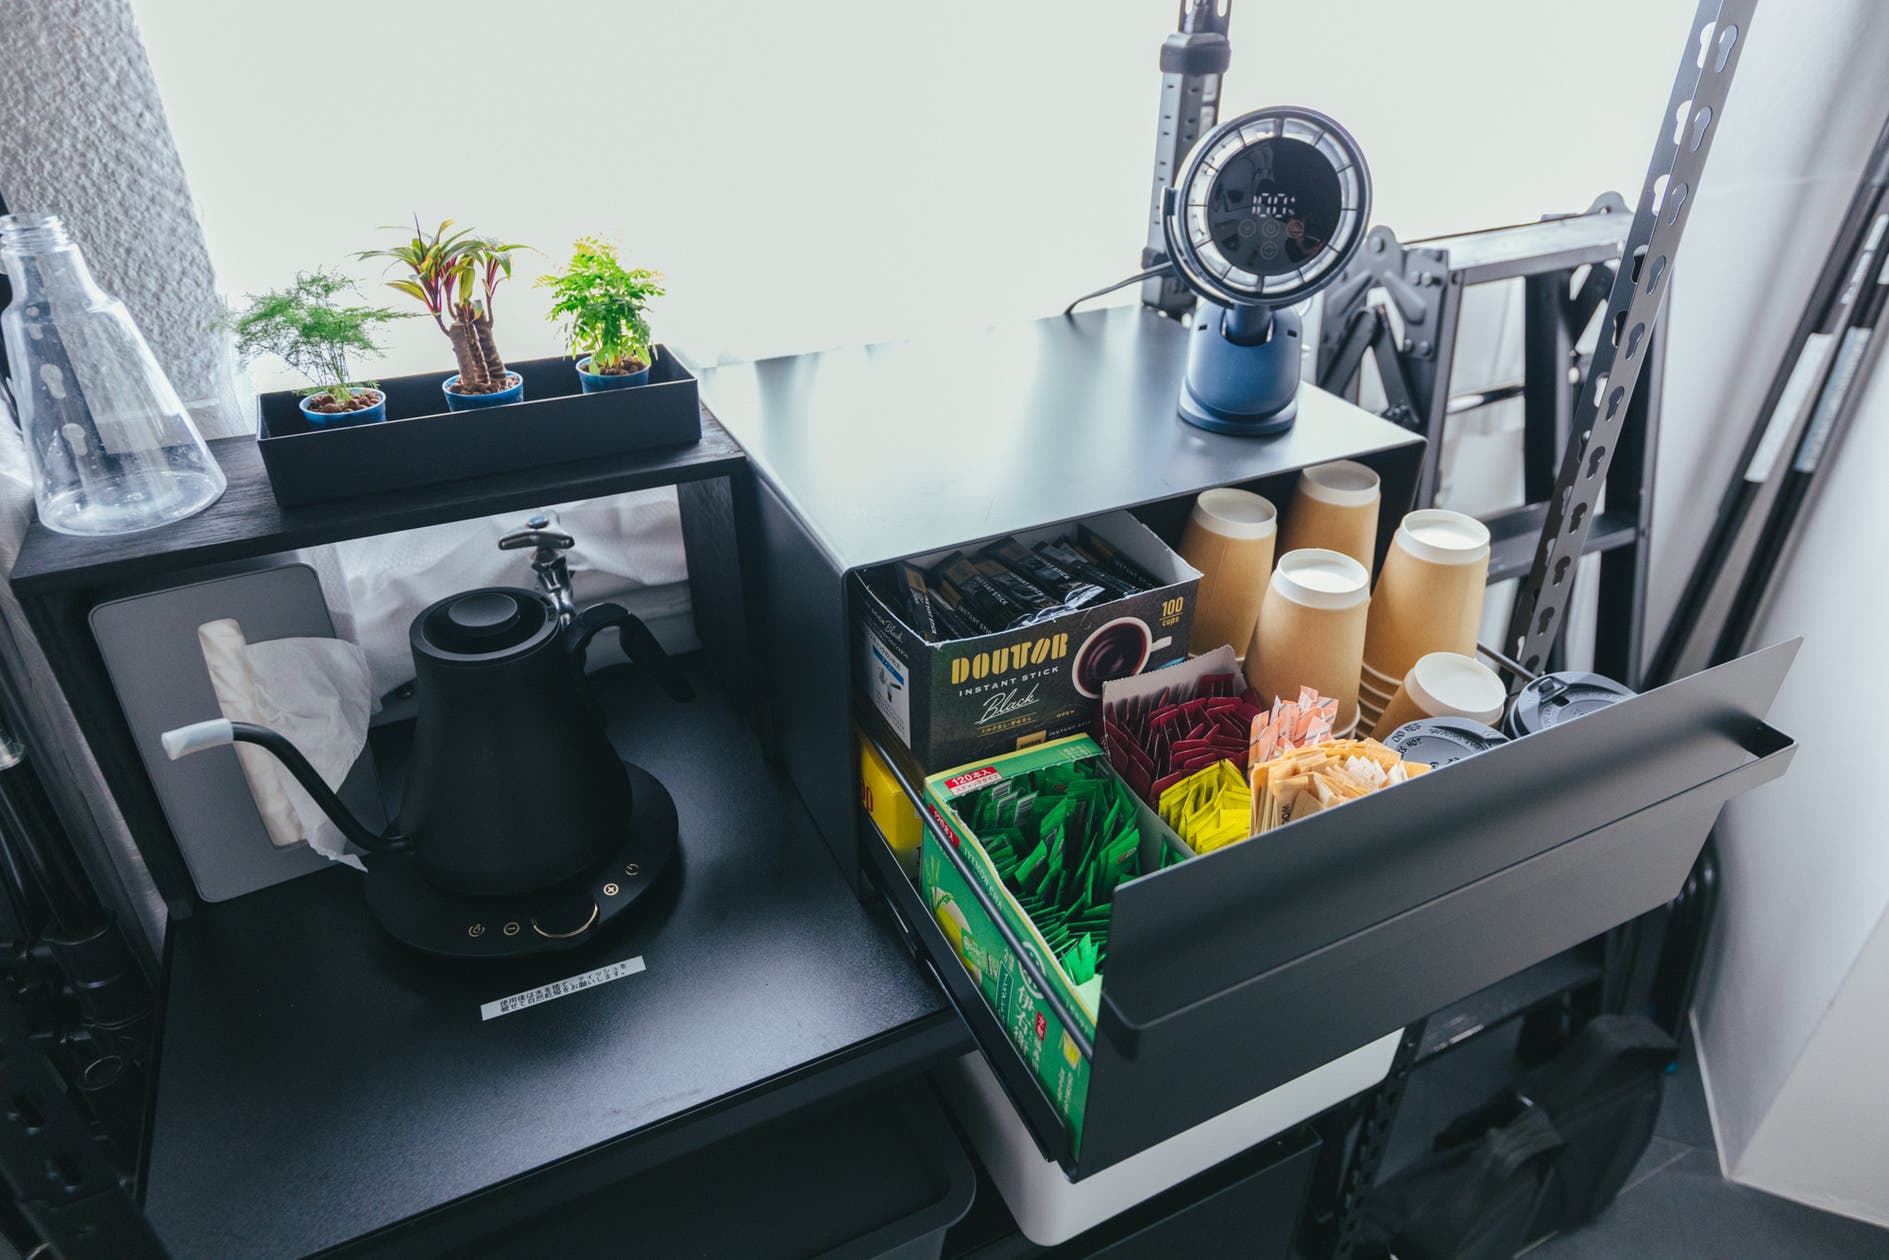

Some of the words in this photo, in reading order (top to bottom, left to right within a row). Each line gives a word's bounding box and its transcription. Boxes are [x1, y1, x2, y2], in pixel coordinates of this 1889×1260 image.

[1161, 596, 1184, 617] 100
[1161, 616, 1181, 628] cups
[951, 632, 1069, 685] DOUTOR
[959, 678, 1017, 697] INSTANT
[1021, 665, 1059, 682] STICK
[975, 683, 1040, 725] Black
[951, 767, 992, 787] 120本入
